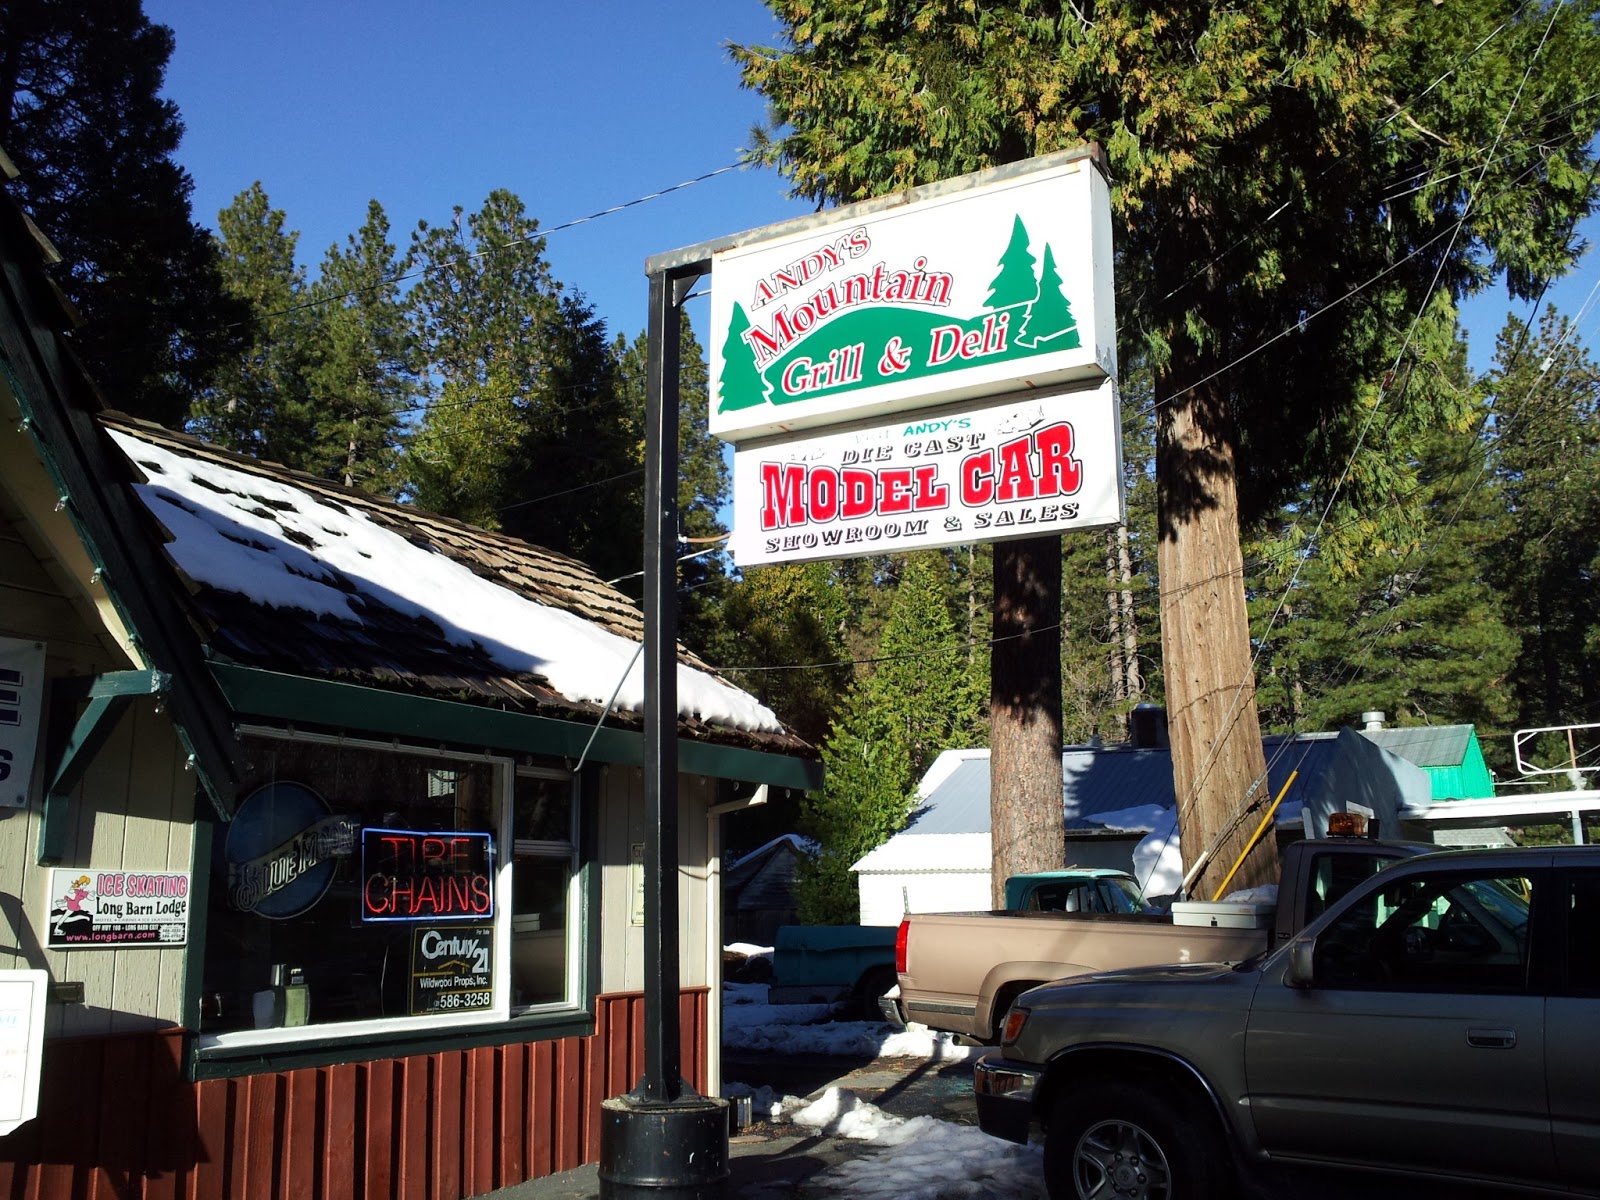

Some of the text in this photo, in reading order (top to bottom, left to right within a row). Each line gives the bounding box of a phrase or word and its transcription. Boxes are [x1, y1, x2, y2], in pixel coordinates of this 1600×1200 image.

[752, 227, 871, 311] ANDY'S
[744, 257, 954, 370] Mountain
[782, 313, 1009, 395] Grill & Deli
[902, 418, 971, 437] ANDY'S
[841, 433, 986, 465] DIE CAST
[761, 421, 1083, 531] MODEL CAR
[765, 503, 1080, 553] SHOWROOM & SALES
[97, 874, 188, 898] ICE SKATING
[365, 873, 490, 913] CHAINS
[96, 897, 186, 918] Long Barn Lodge
[66, 932, 155, 942] www.longbarn.com
[421, 930, 479, 959] Century
[472, 947, 489, 973] 21
[420, 977, 452, 989] Wildwood
[441, 993, 490, 1007] 586-3258
